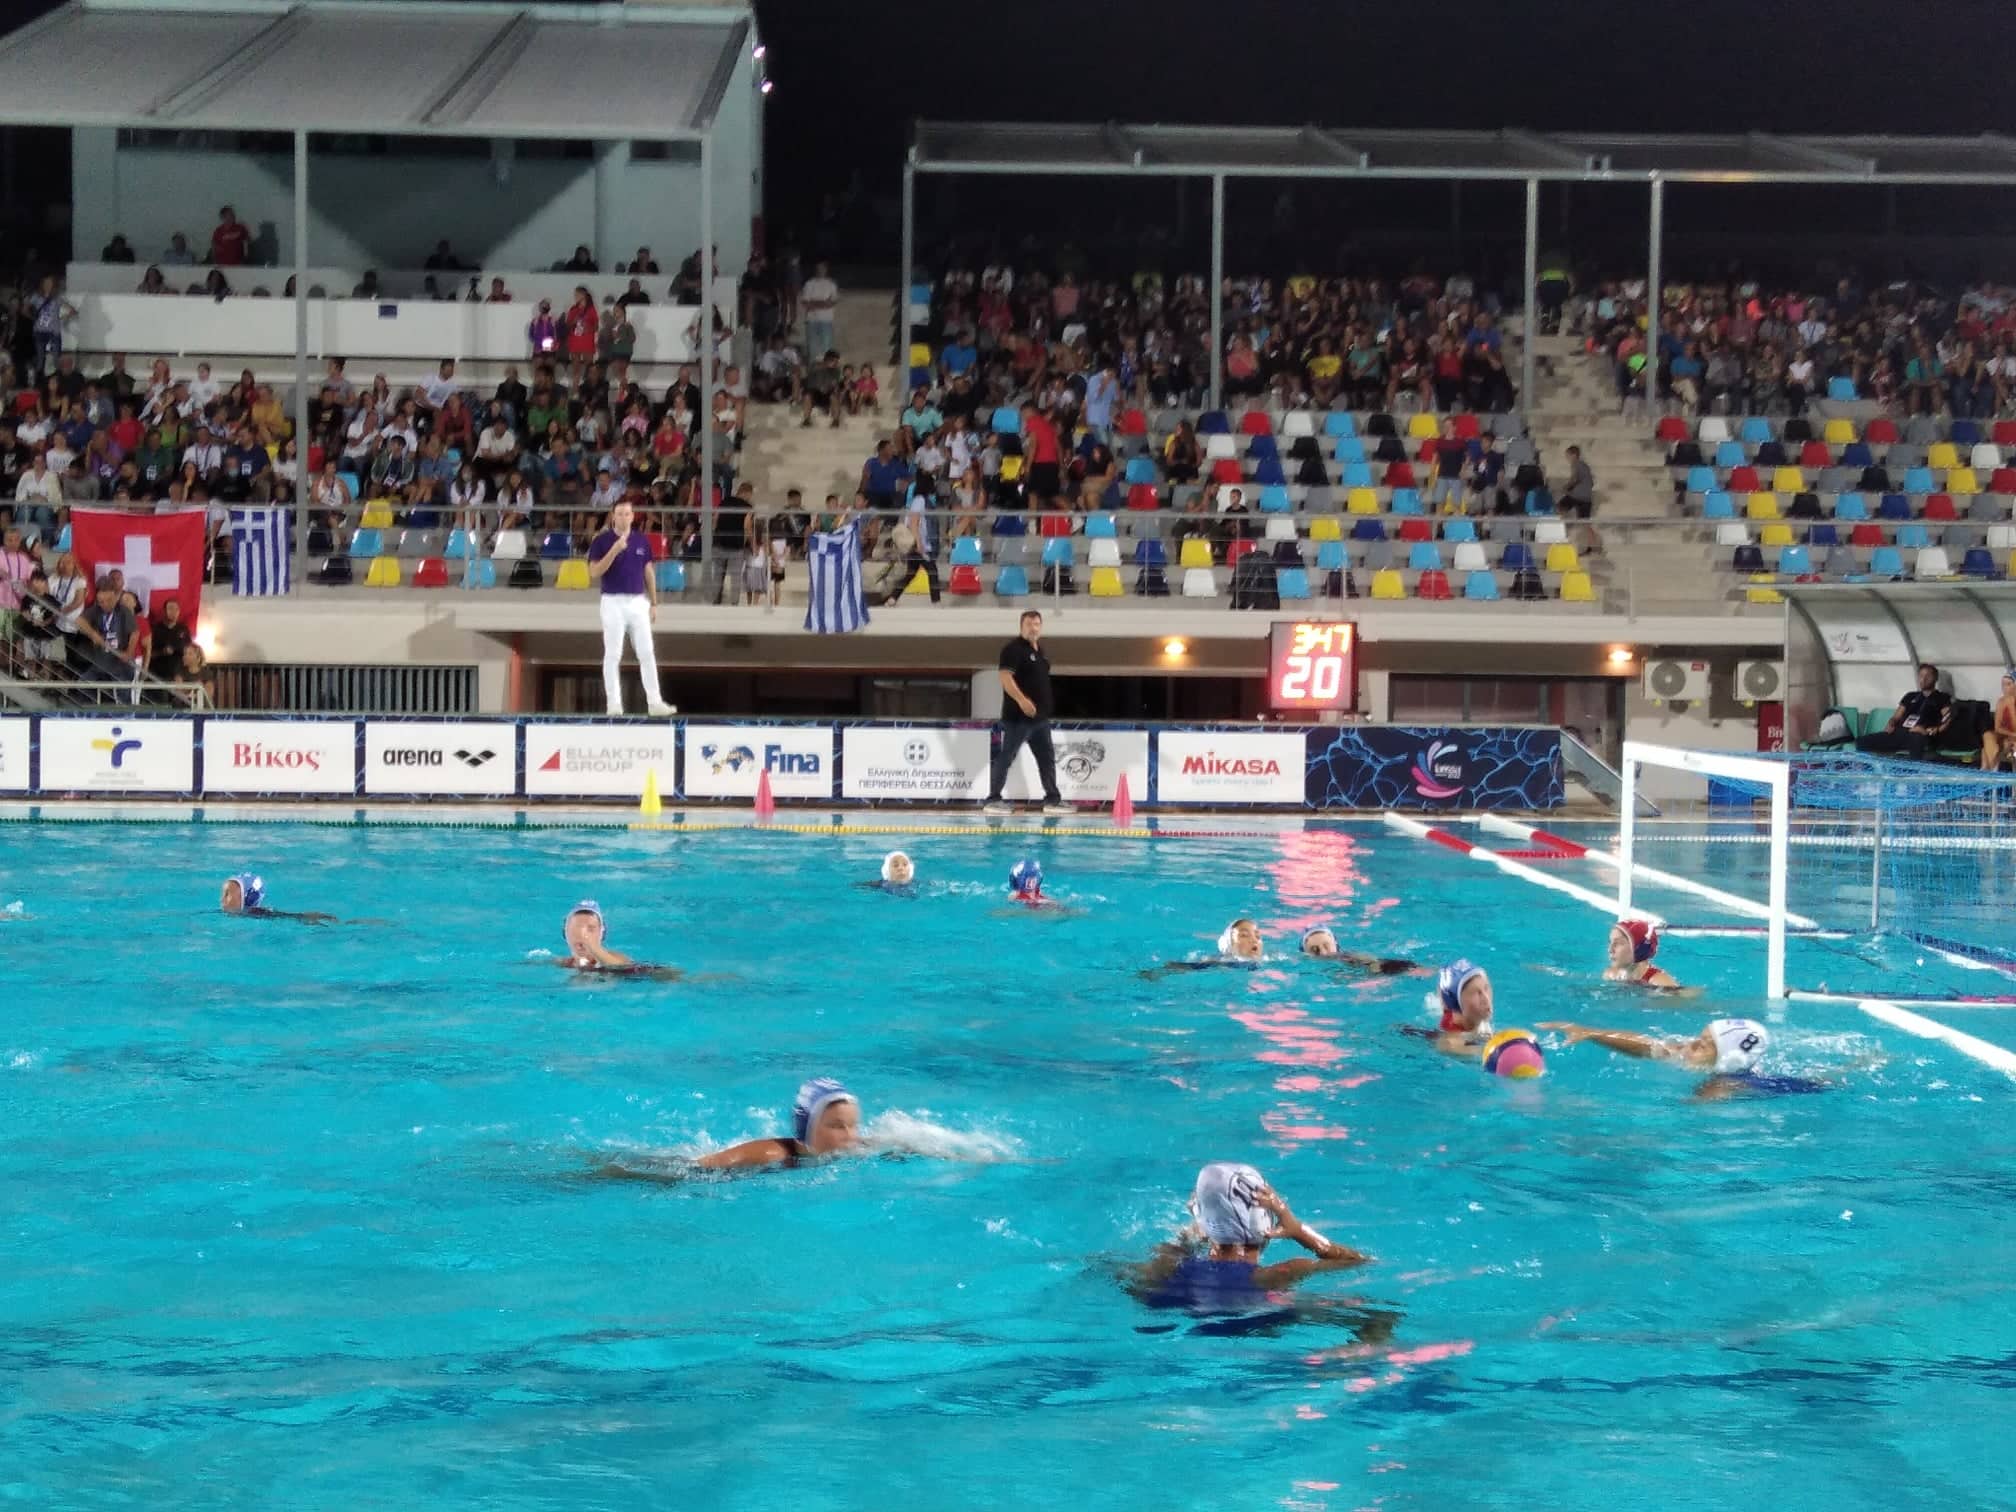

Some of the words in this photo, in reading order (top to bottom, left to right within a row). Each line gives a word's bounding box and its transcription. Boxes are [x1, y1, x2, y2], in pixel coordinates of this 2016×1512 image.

[1281, 655, 1342, 699] 20
[233, 742, 320, 772] Βίκος
[383, 749, 443, 767] arena
[565, 747, 664, 761] ELLAKTOR
[764, 743, 820, 774] Fina
[565, 760, 633, 773] GROUP
[1740, 1033, 1759, 1053] 8
